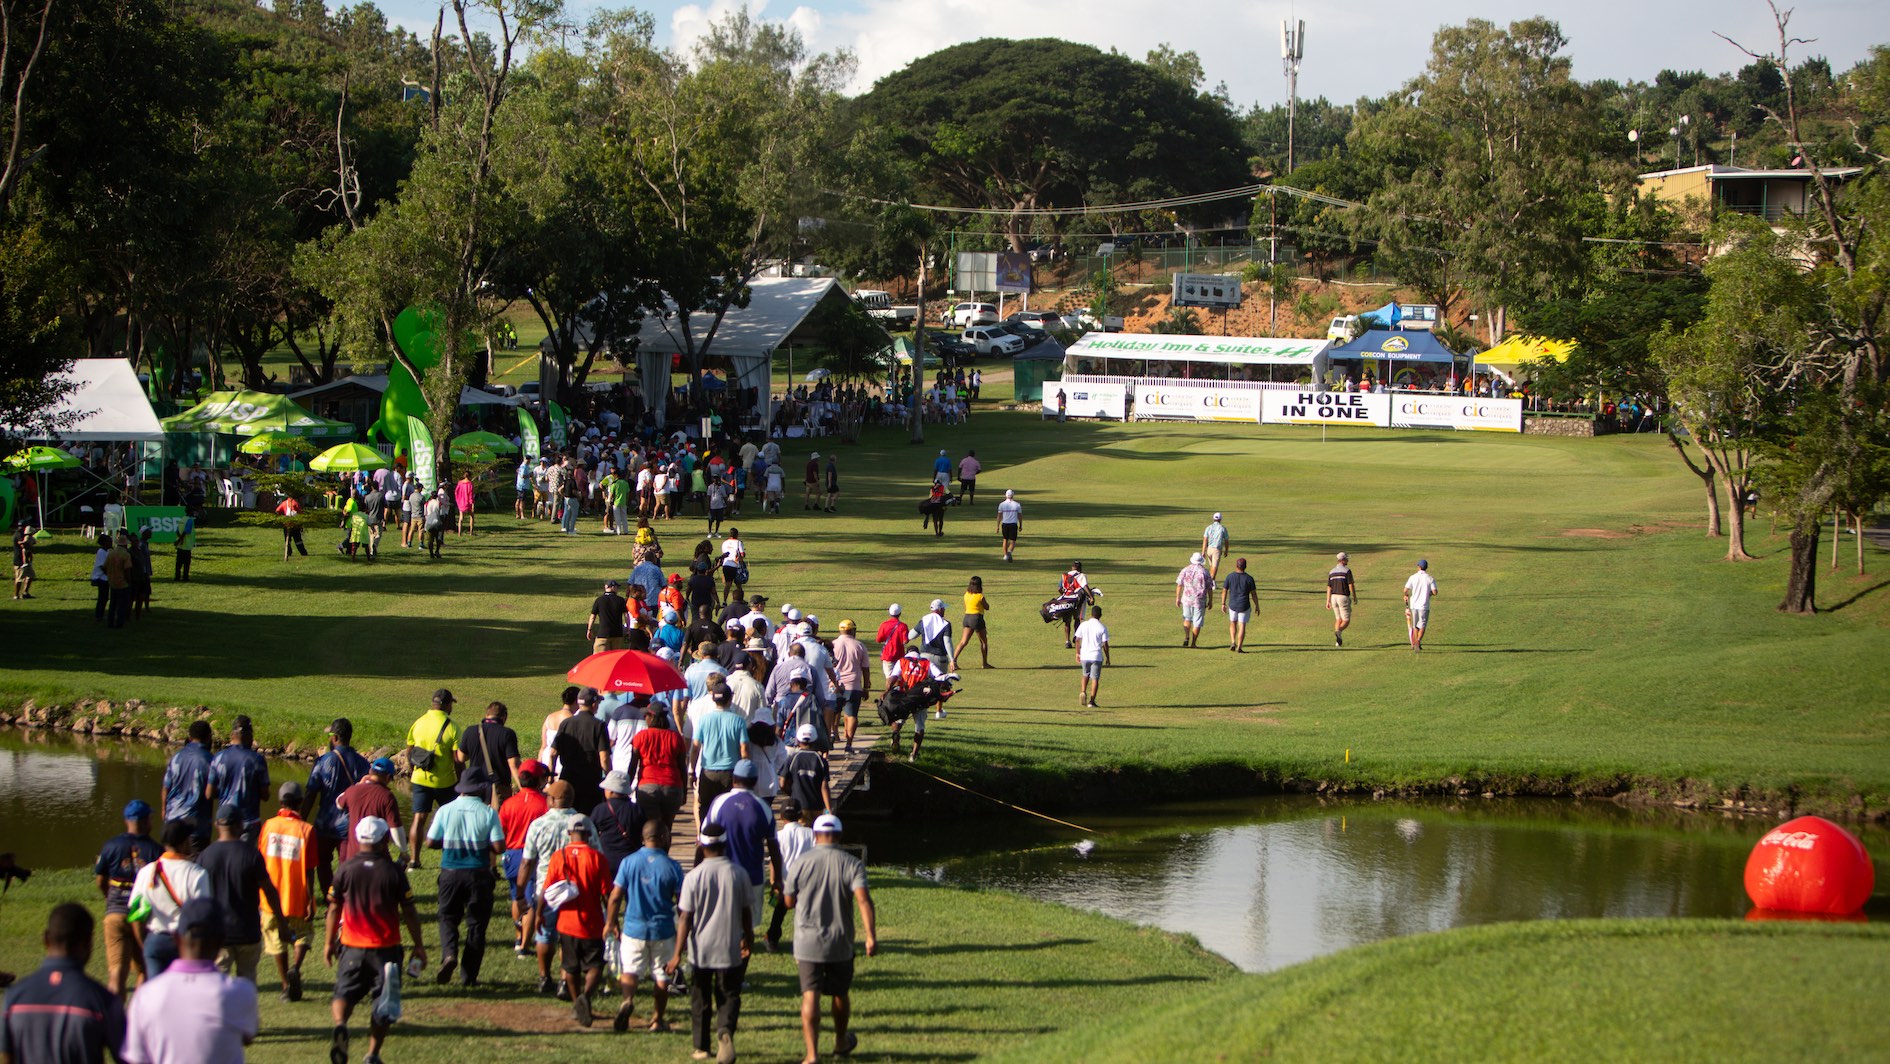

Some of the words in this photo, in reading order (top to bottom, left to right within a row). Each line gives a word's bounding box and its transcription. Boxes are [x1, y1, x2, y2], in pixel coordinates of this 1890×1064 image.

[1088, 340, 1159, 351] Holiday
[1161, 342, 1193, 351] Inn
[1195, 343, 1210, 352] &
[1213, 343, 1273, 354] Suites
[1387, 352, 1422, 360] EQUIPMENT
[1298, 393, 1363, 406] HOLE
[1282, 405, 1306, 416] IN
[1318, 406, 1369, 419] ONE
[414, 439, 433, 479] BSP
[150, 516, 181, 532] BSP
